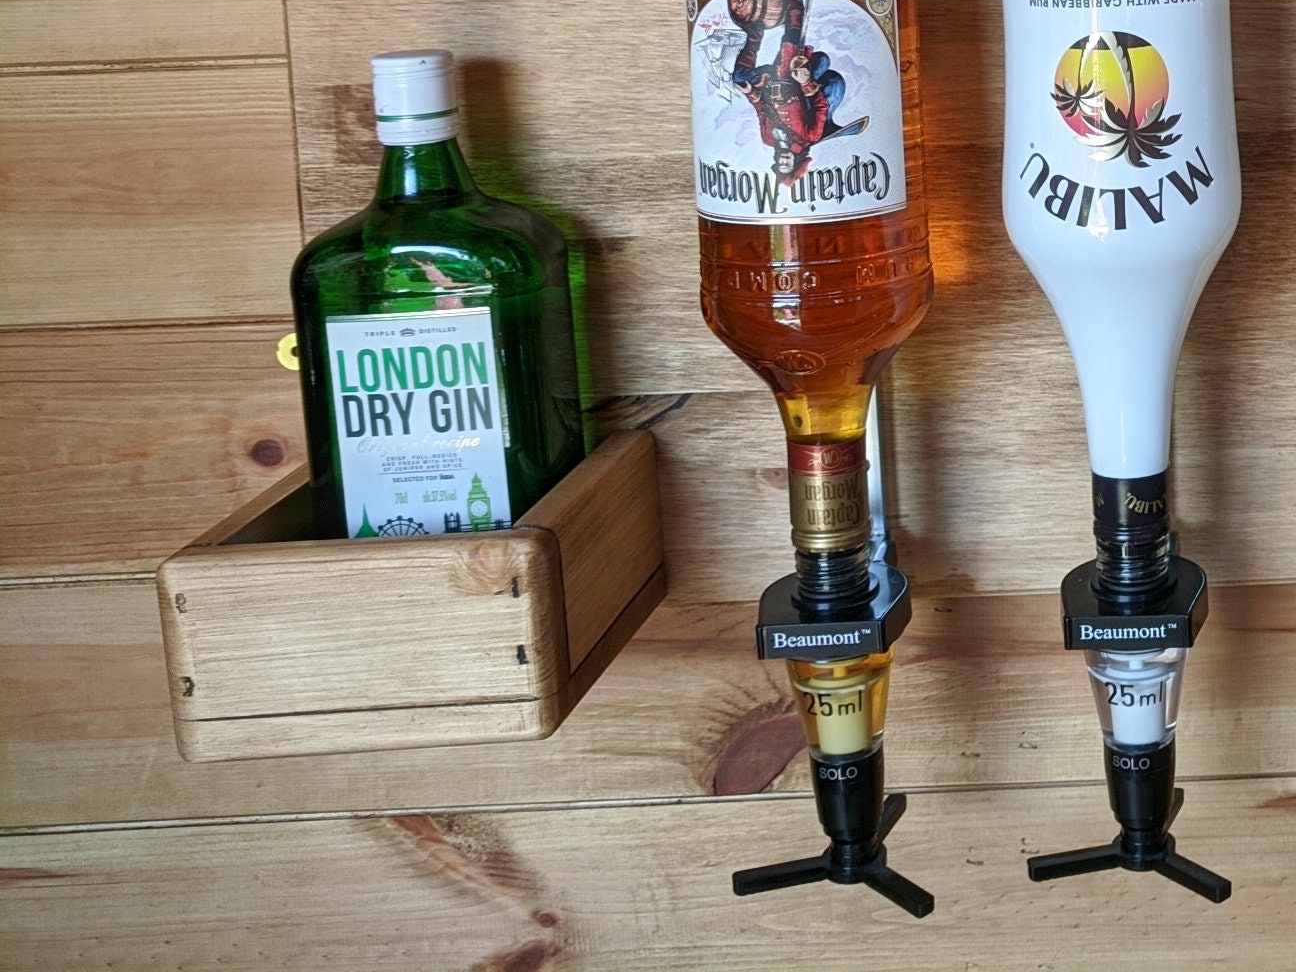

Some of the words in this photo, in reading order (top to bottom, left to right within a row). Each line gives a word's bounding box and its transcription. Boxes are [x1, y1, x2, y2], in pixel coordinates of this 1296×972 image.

[698, 157, 788, 214] Morgan
[790, 152, 890, 212] Captain
[1020, 145, 1214, 231] MALIBU
[336, 342, 489, 393] LONDON
[342, 392, 415, 438] DRY
[429, 387, 494, 434] GIN
[1124, 492, 1166, 514] ALIBU
[819, 766, 858, 781] SOLO
[1112, 755, 1150, 771] SOLO
